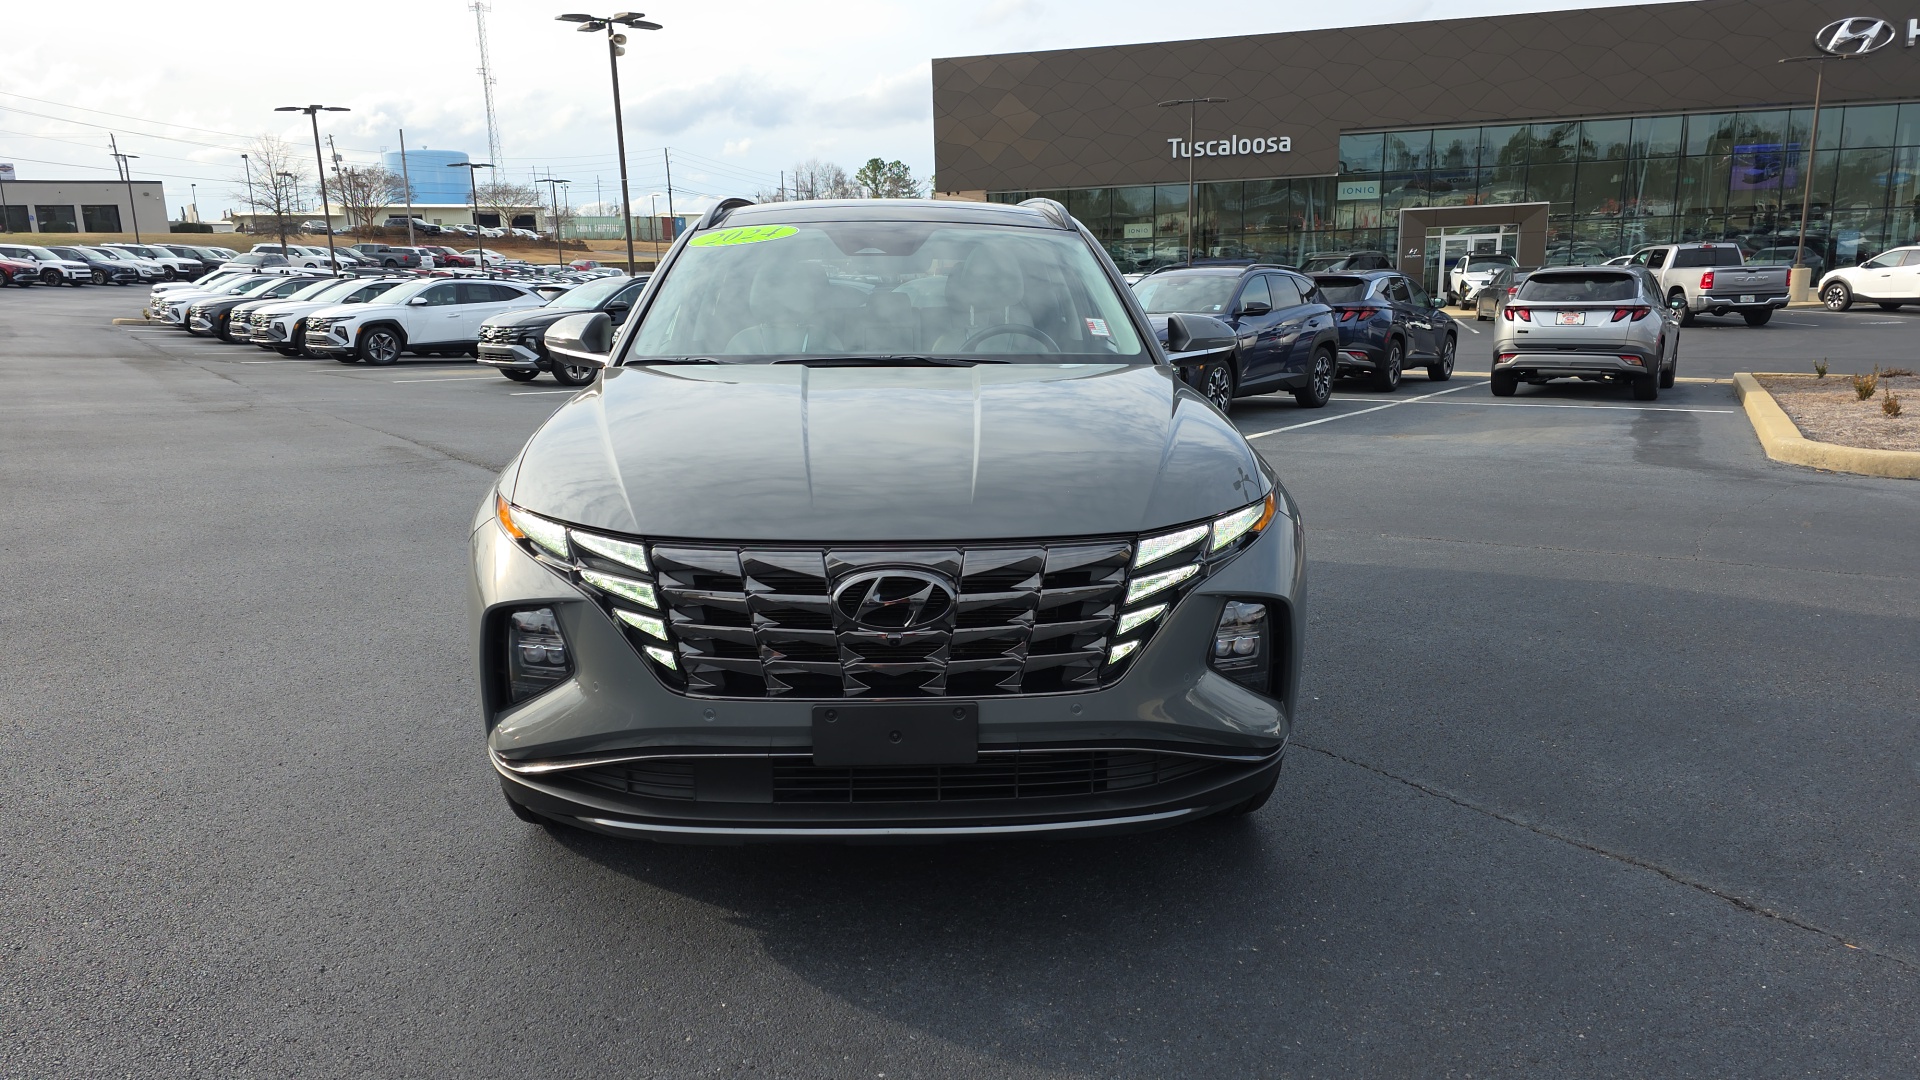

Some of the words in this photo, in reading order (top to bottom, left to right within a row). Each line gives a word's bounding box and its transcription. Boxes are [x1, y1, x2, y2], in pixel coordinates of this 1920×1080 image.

[1167, 134, 1291, 159] Tuscaloosa
[1342, 186, 1375, 195] IONIQ
[576, 224, 592, 233] CHINA
[594, 224, 620, 233] SHIPPING
[704, 227, 783, 245] 2024
